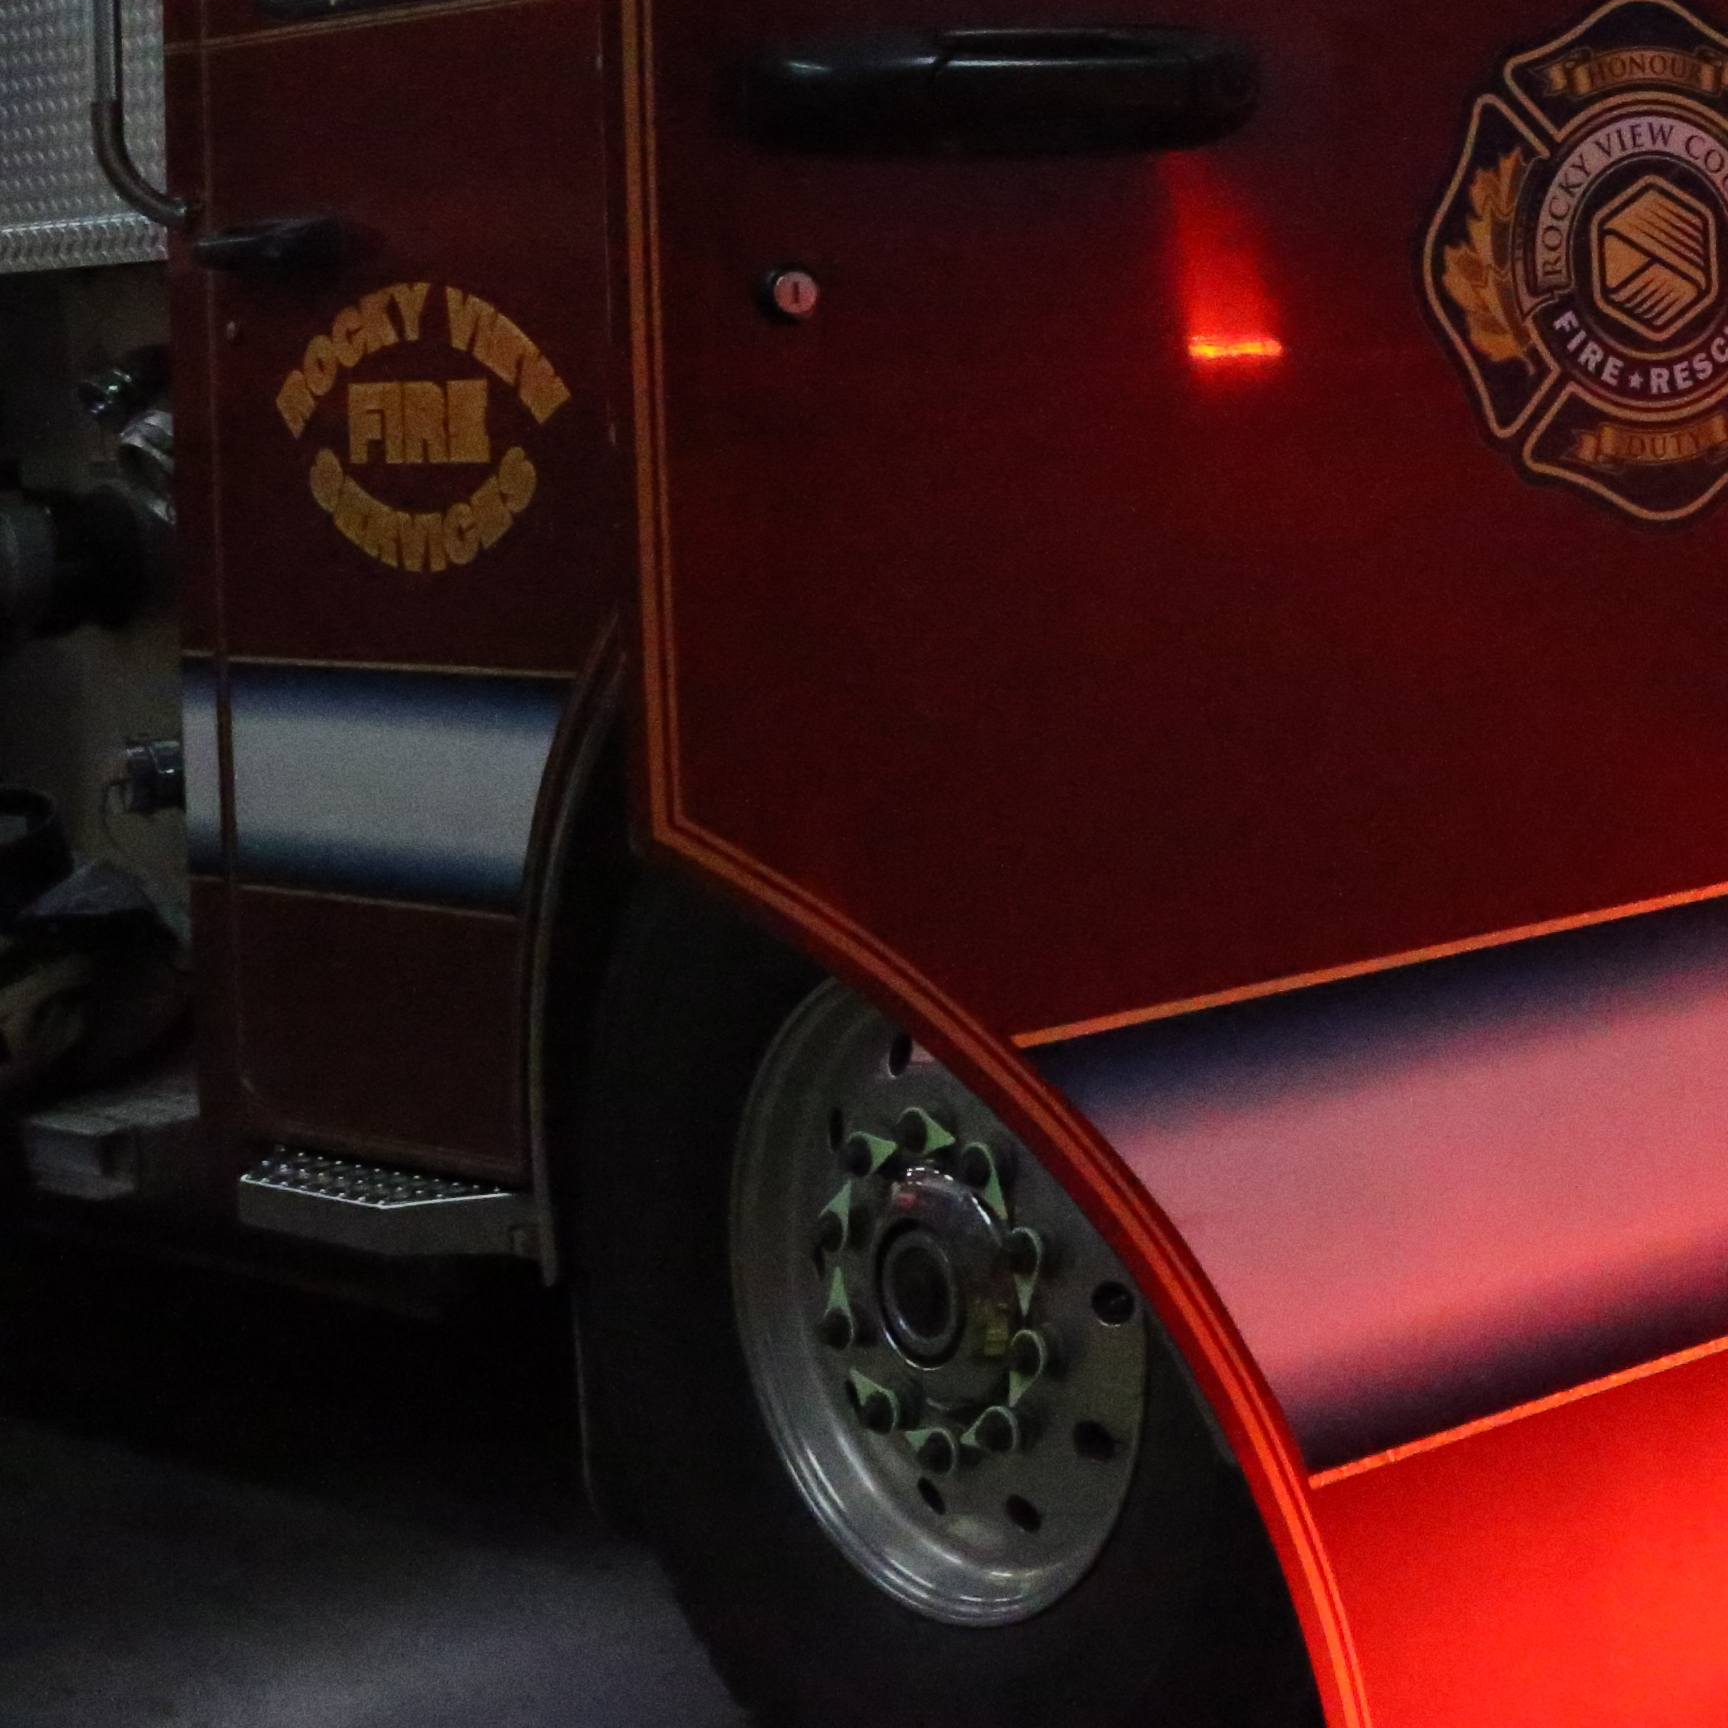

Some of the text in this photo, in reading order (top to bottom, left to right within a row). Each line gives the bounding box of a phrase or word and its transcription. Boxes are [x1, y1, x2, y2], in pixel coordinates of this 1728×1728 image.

[1542, 152, 1592, 282] ROCKY
[1597, 122, 1676, 155] VIEW
[275, 282, 573, 439] ROCKY VIEW
[1552, 309, 1626, 386] FIRE
[347, 378, 492, 464] FIRE
[1627, 431, 1700, 459] DUTY
[308, 446, 537, 572] SERVICES
